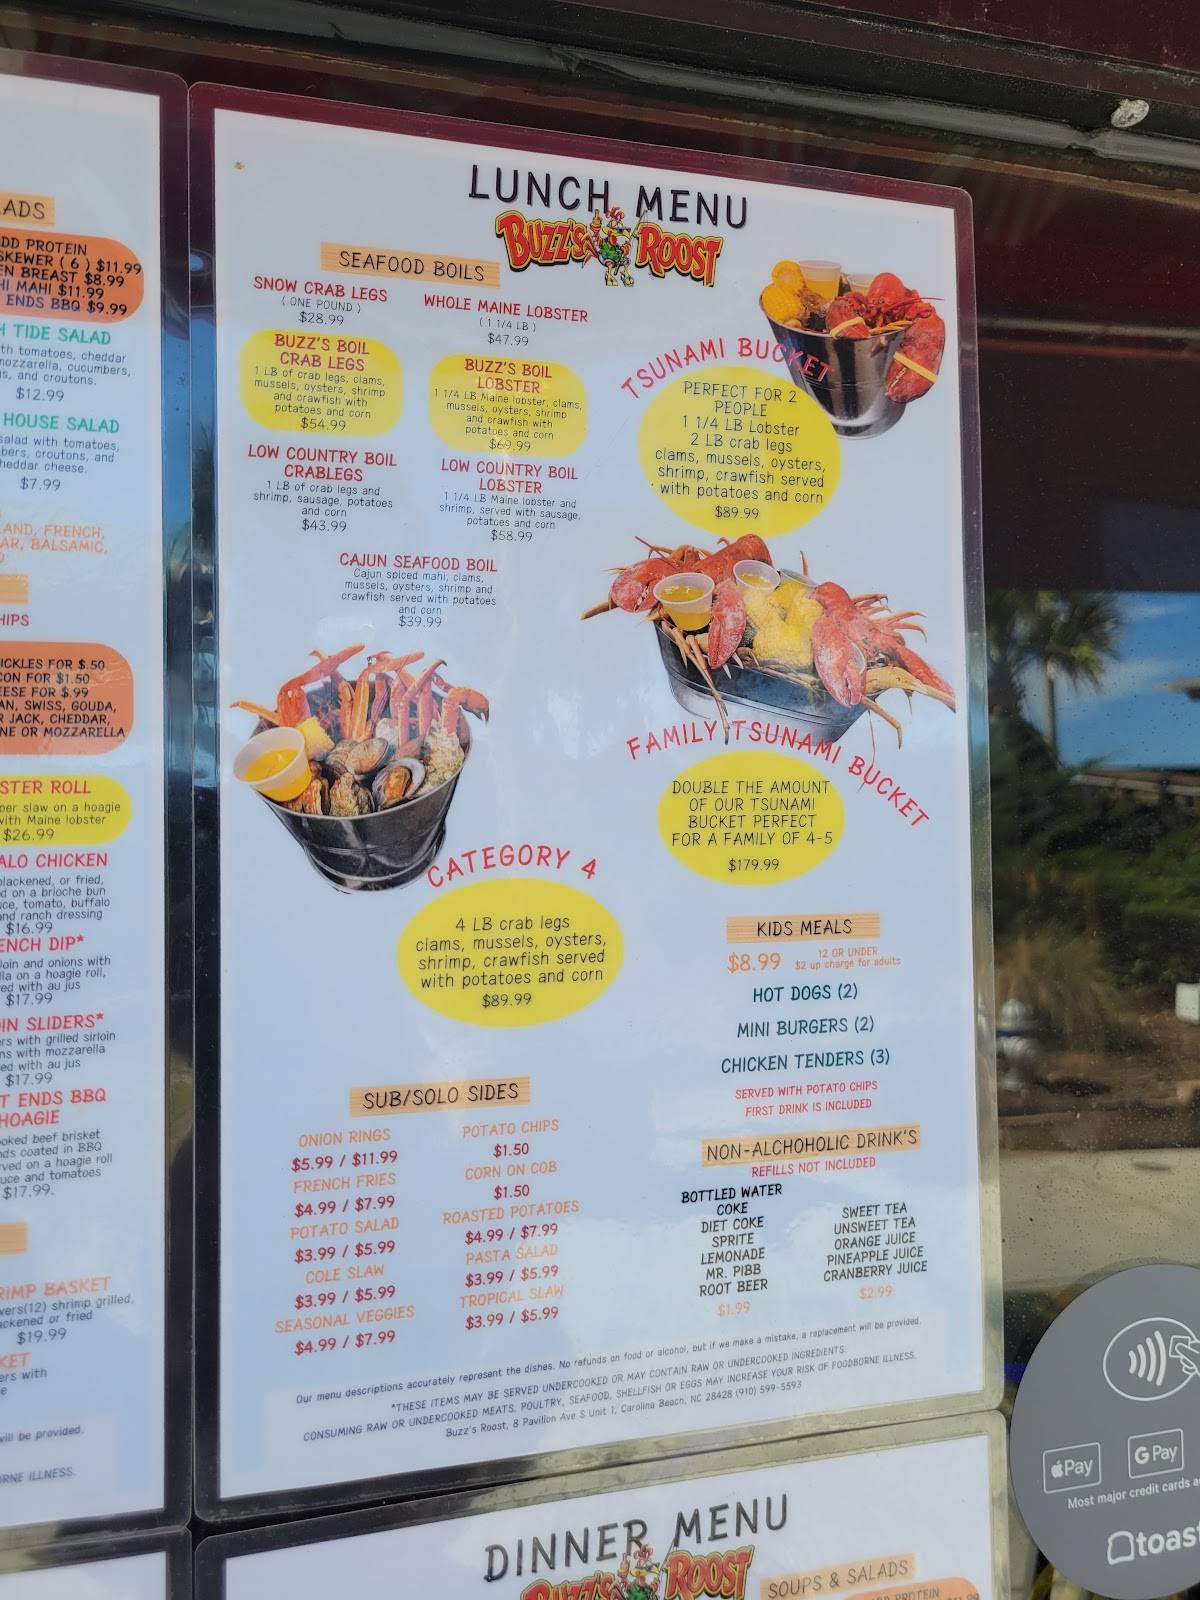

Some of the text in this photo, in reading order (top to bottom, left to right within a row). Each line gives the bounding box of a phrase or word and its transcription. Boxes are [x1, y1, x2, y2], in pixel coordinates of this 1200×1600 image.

[469, 164, 747, 229] LUNCH MENU
[26, 240, 87, 255] PROTEIN
[339, 251, 484, 281] SEAFOOD BOILS
[22, 267, 124, 288] BREAST $8.99
[254, 277, 387, 302] SNOW CRAB LEGS
[424, 294, 588, 322] WHOLE MAINE LOBSTER
[299, 312, 344, 326] $28.99
[15, 325, 111, 345] TIDE SALAD
[275, 334, 369, 354] BUZZ'S BOIL
[487, 333, 529, 346] $47.99
[280, 352, 365, 371] CRAB LEGS
[621, 338, 831, 399] TSUNAMI BUCKET
[16, 387, 64, 401] $12.99
[684, 381, 796, 403] PERFECT FOR 2
[715, 401, 767, 417] PEOPLE
[4, 412, 120, 433] HOUSE SALAD
[301, 417, 346, 431] $54.99
[248, 445, 397, 467] LOW COUNTRY BOIL
[284, 465, 363, 482] CRABLEGS
[20, 476, 60, 491] $7.99
[715, 505, 759, 519] $89.99
[302, 519, 347, 532] $43.99
[340, 553, 497, 572] CAJUN SEAFOOD BOIL
[399, 616, 442, 629] $39.99
[25, 701, 117, 713] SWISS, GOUDA,
[44, 727, 125, 737] MOZZARELLA
[626, 720, 929, 827] FAMILY TSUNAMI BUCKET
[672, 780, 831, 795] DOUBLE THE AMOUNT
[84, 801, 121, 815] hoagie
[689, 797, 815, 811] OF OUR TSUNAMI
[688, 814, 816, 829] BUCKET PERFECT
[36, 853, 108, 867] CHICKEN
[427, 844, 597, 888] CATEGORY 4
[728, 859, 779, 873] $179.99
[455, 915, 570, 932] 4 LB crab legs
[757, 919, 853, 937] KIDS MEALS
[418, 950, 605, 971] shrimp, crawfish served
[727, 953, 781, 973] $8.99
[421, 969, 602, 989] with potatoes and corn
[482, 993, 531, 1009] $89.99
[753, 983, 858, 1003] HOT DOGS (2)
[737, 1016, 874, 1038] MINI BURGERS (2)
[721, 1048, 890, 1073] CHICKEN TENDERS (3)
[363, 1083, 519, 1109] SUB/SOLO SIDES
[735, 1081, 878, 1099] SERVED WITH POTATO CHIPS
[746, 1099, 872, 1117] FIRST DRINK IS INCLUDED
[299, 1129, 391, 1147] ONION RINGS
[463, 1119, 560, 1138] POTATO CHIPS
[493, 1143, 529, 1158] $1.50
[707, 1129, 917, 1161] NON-ALCHOHOLIC DRINK'S
[291, 1150, 398, 1173] $5.99 / $11.99
[752, 1157, 876, 1178] REFILLS NOT INCLUDED
[293, 1173, 396, 1194] FRENCH FRIES
[681, 1184, 782, 1203] BOTTLED WATER
[842, 1202, 907, 1219] SWEET TEA
[834, 1232, 916, 1250] ORANGE JUICE
[824, 1261, 928, 1282] CRANBERRY JUICE
[700, 1279, 768, 1297] ROOT BEER
[446, 1426, 477, 1438] Buzz's
[481, 1422, 509, 1433] Roost,
[513, 1418, 519, 1428] 8
[522, 1413, 557, 1426] Pavilion
[560, 1410, 576, 1421] Ave
[579, 1409, 585, 1419] S
[588, 1407, 607, 1418] Unit
[621, 1401, 655, 1415] Carolina
[691, 1394, 702, 1405] NC
[706, 1390, 733, 1403] 28428
[735, 1386, 757, 1398] (910)
[760, 1380, 802, 1393] 599-5593
[1064, 1459, 1093, 1477] Pay
[1068, 1498, 1094, 1509] Most
[1098, 1490, 1126, 1503] major
[1129, 1484, 1160, 1497] credit
[1162, 1478, 1190, 1492] cards
[483, 1494, 788, 1582] DINNER MENU
[768, 1559, 909, 1599] SOUPS & SALADS
